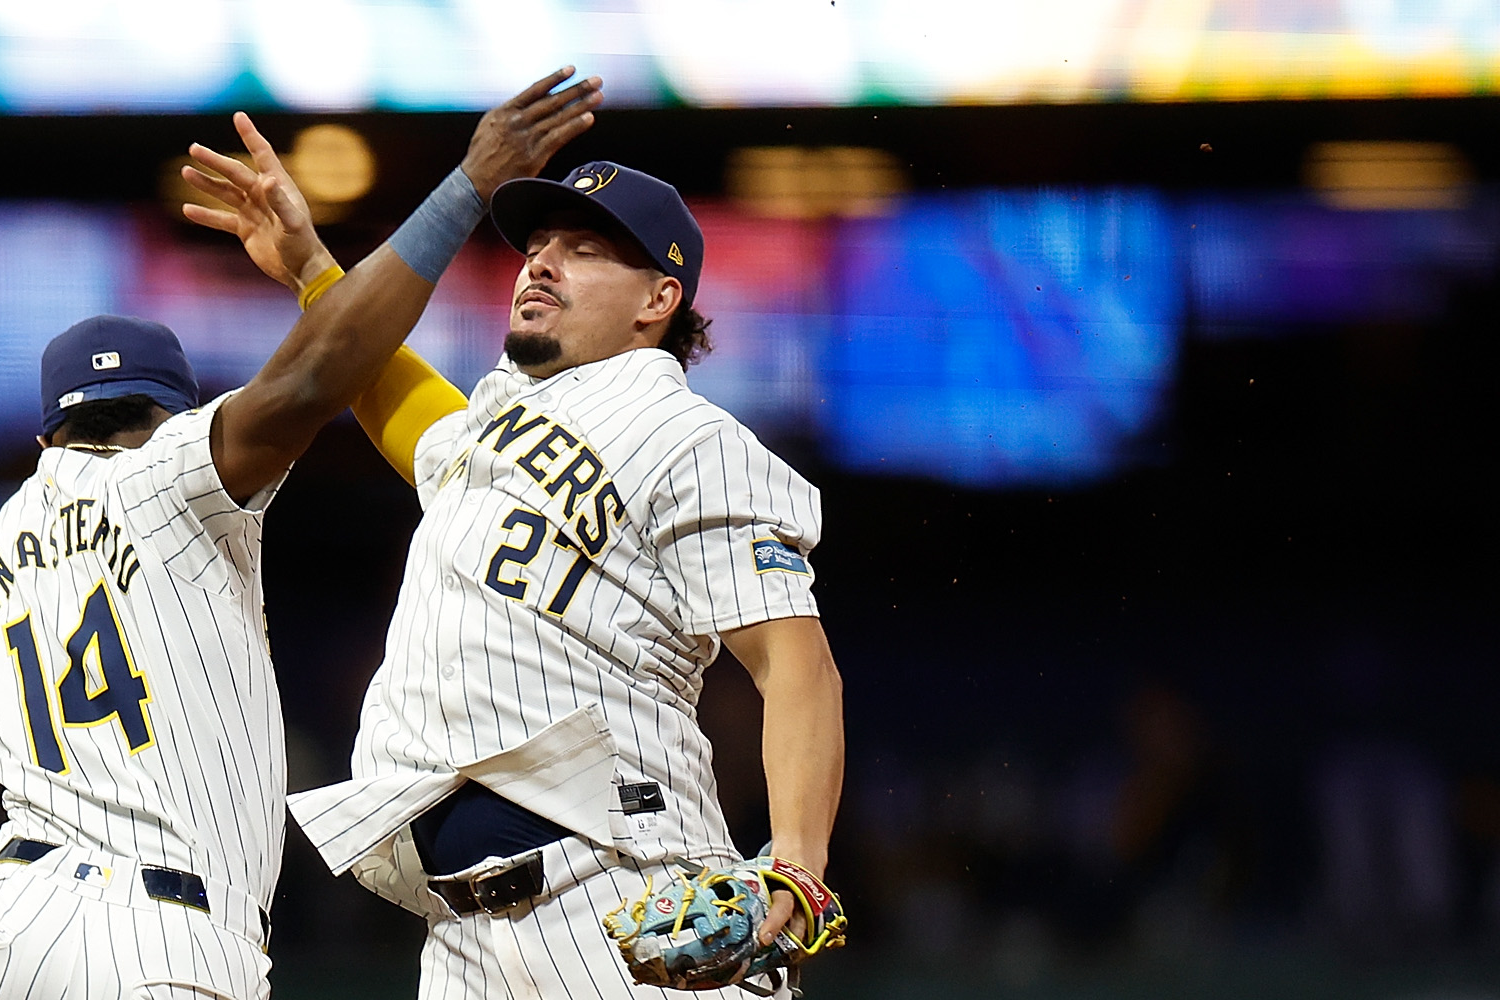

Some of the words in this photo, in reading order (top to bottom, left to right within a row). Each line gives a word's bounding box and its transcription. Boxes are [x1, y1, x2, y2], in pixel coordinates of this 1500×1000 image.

[440, 404, 626, 560] WERS
[485, 507, 594, 617] 27
[2, 577, 155, 775] 14
